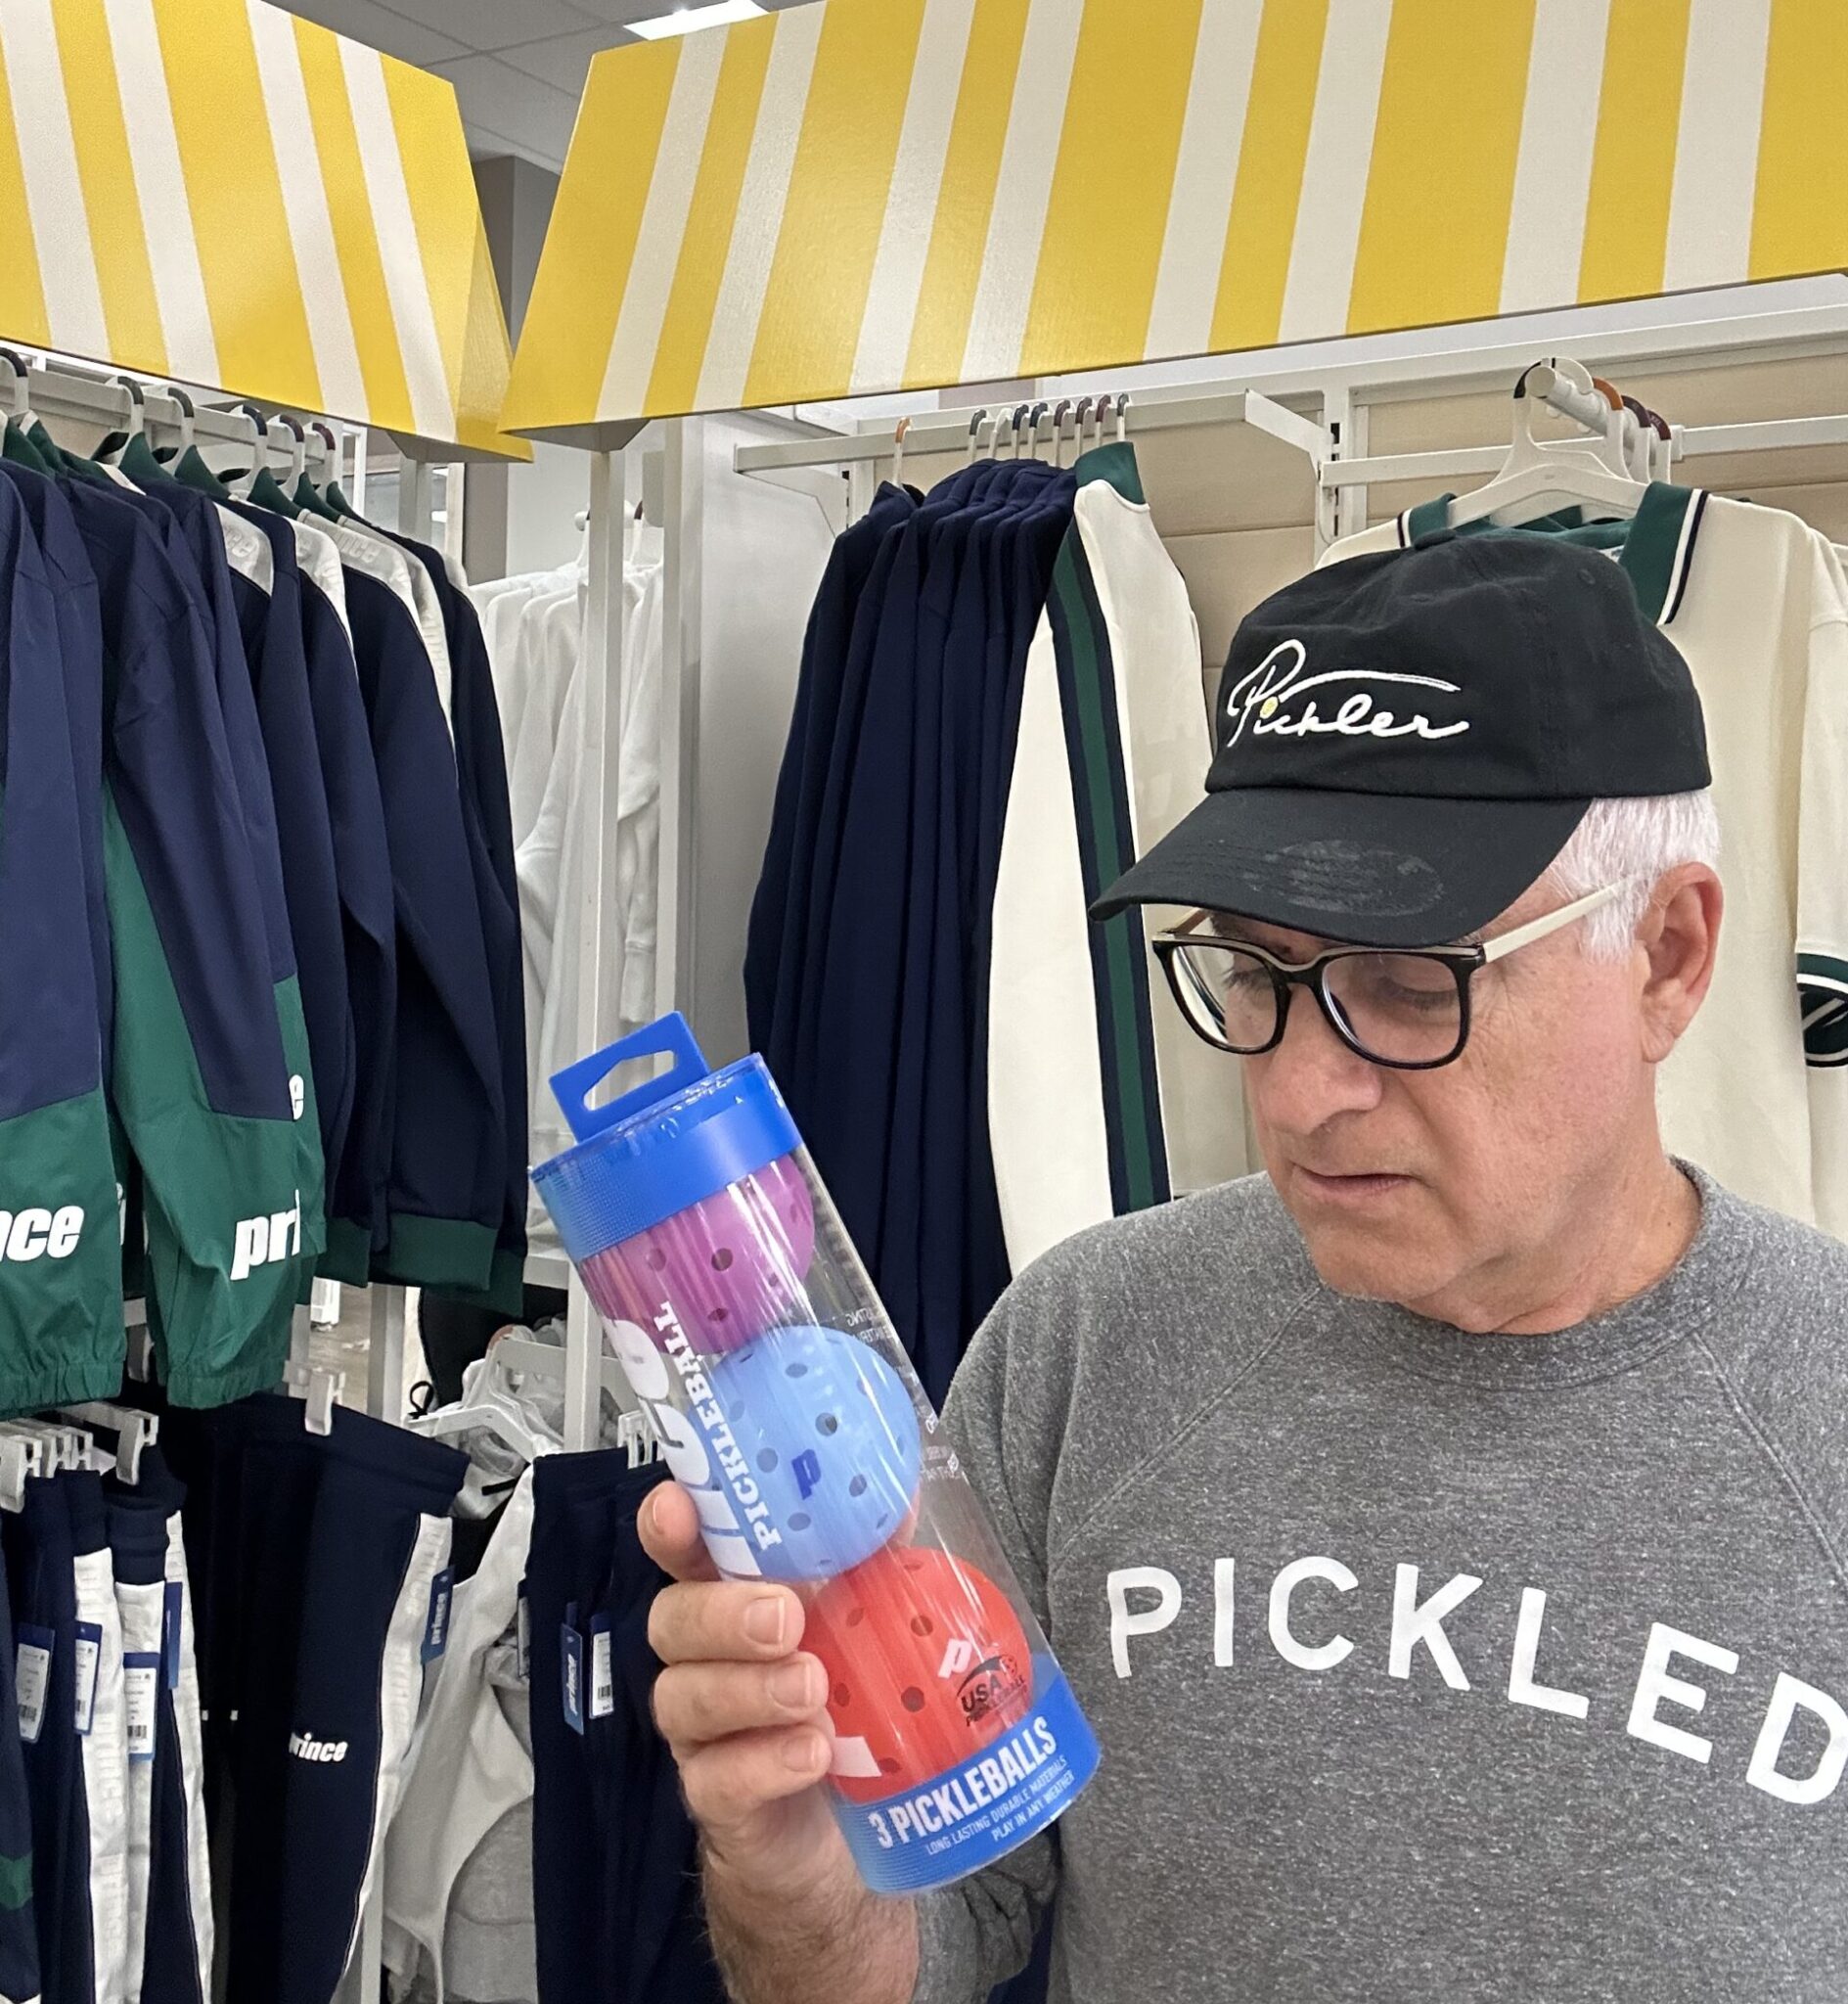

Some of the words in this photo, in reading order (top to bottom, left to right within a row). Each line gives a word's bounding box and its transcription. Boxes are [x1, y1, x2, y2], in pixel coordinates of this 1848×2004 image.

[1227, 639, 1469, 748] Pickler
[654, 1300, 783, 1551] PICKLEBALL
[961, 1672, 1002, 1713] USA
[1106, 1556, 1848, 1804] PICKLED
[289, 1732, 348, 1762] rince
[868, 1811, 894, 1849] 3
[888, 1716, 1058, 1845] PICKLEBALLS
[925, 1836, 952, 1855] LONG
[951, 1815, 991, 1845] LASTING
[990, 1788, 1031, 1822] DURABLE
[991, 1820, 1016, 1843] PLAY
[1014, 1811, 1027, 1827] IN
[1026, 1799, 1046, 1819] ANY
